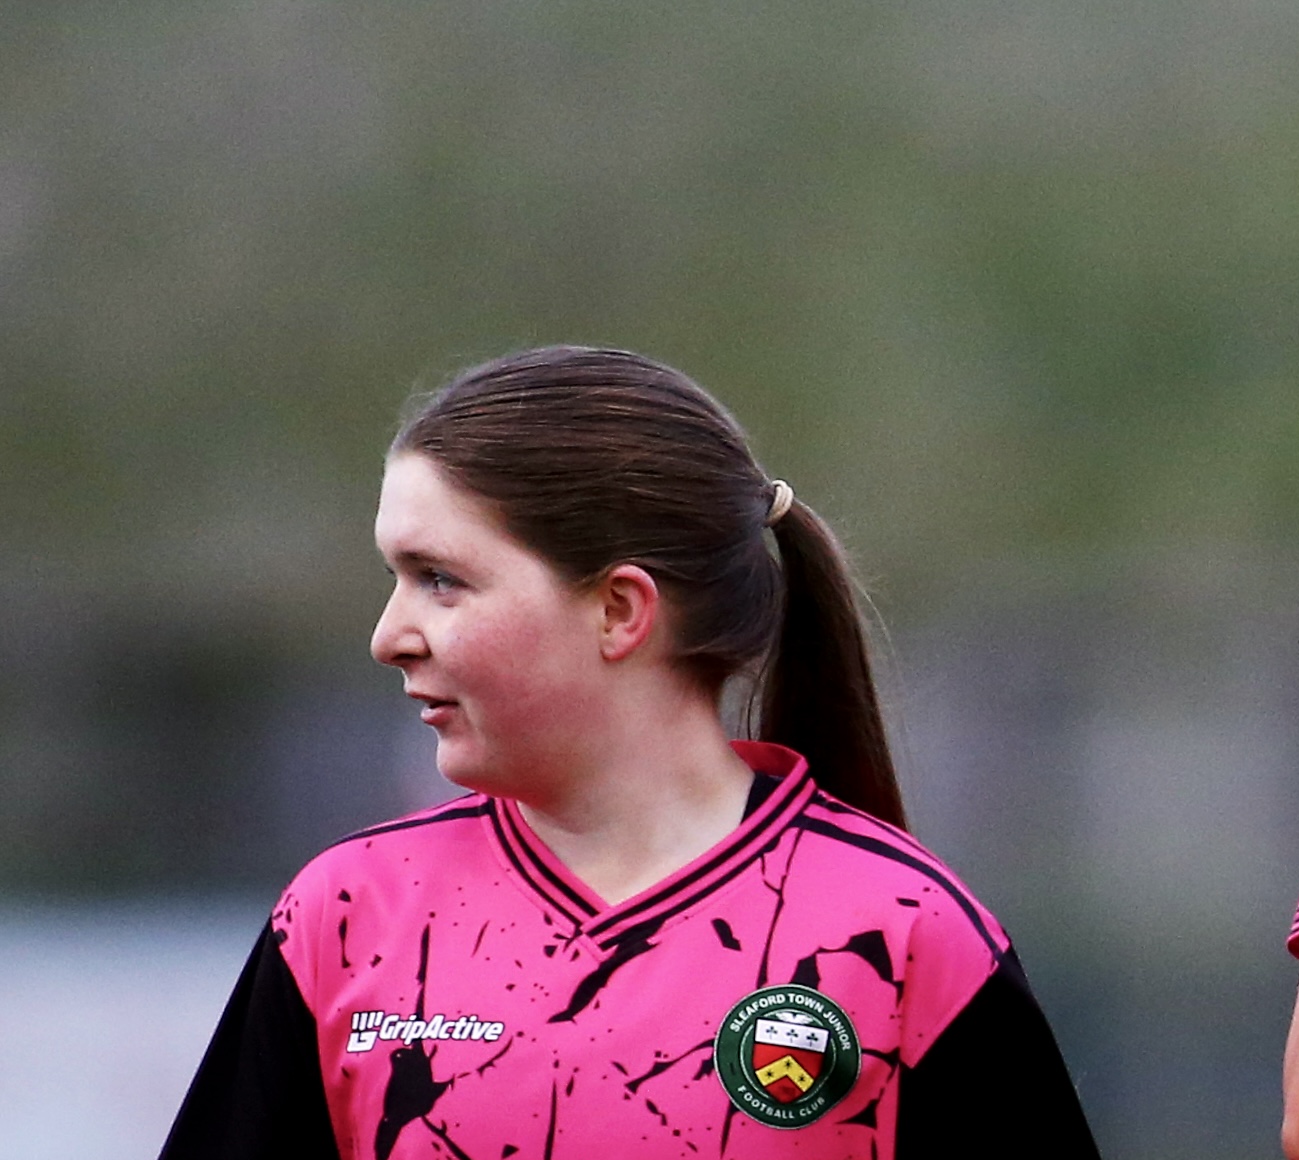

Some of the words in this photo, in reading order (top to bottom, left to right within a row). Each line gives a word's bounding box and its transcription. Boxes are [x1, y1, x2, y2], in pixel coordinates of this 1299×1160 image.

[379, 1014, 504, 1046] GripActive
[729, 993, 786, 1033] SLEAFORD
[787, 993, 825, 1013] TOWN
[823, 1006, 852, 1051] JUNIOR
[737, 1084, 795, 1120] FOOTBALL
[799, 1096, 826, 1117] CLUB
